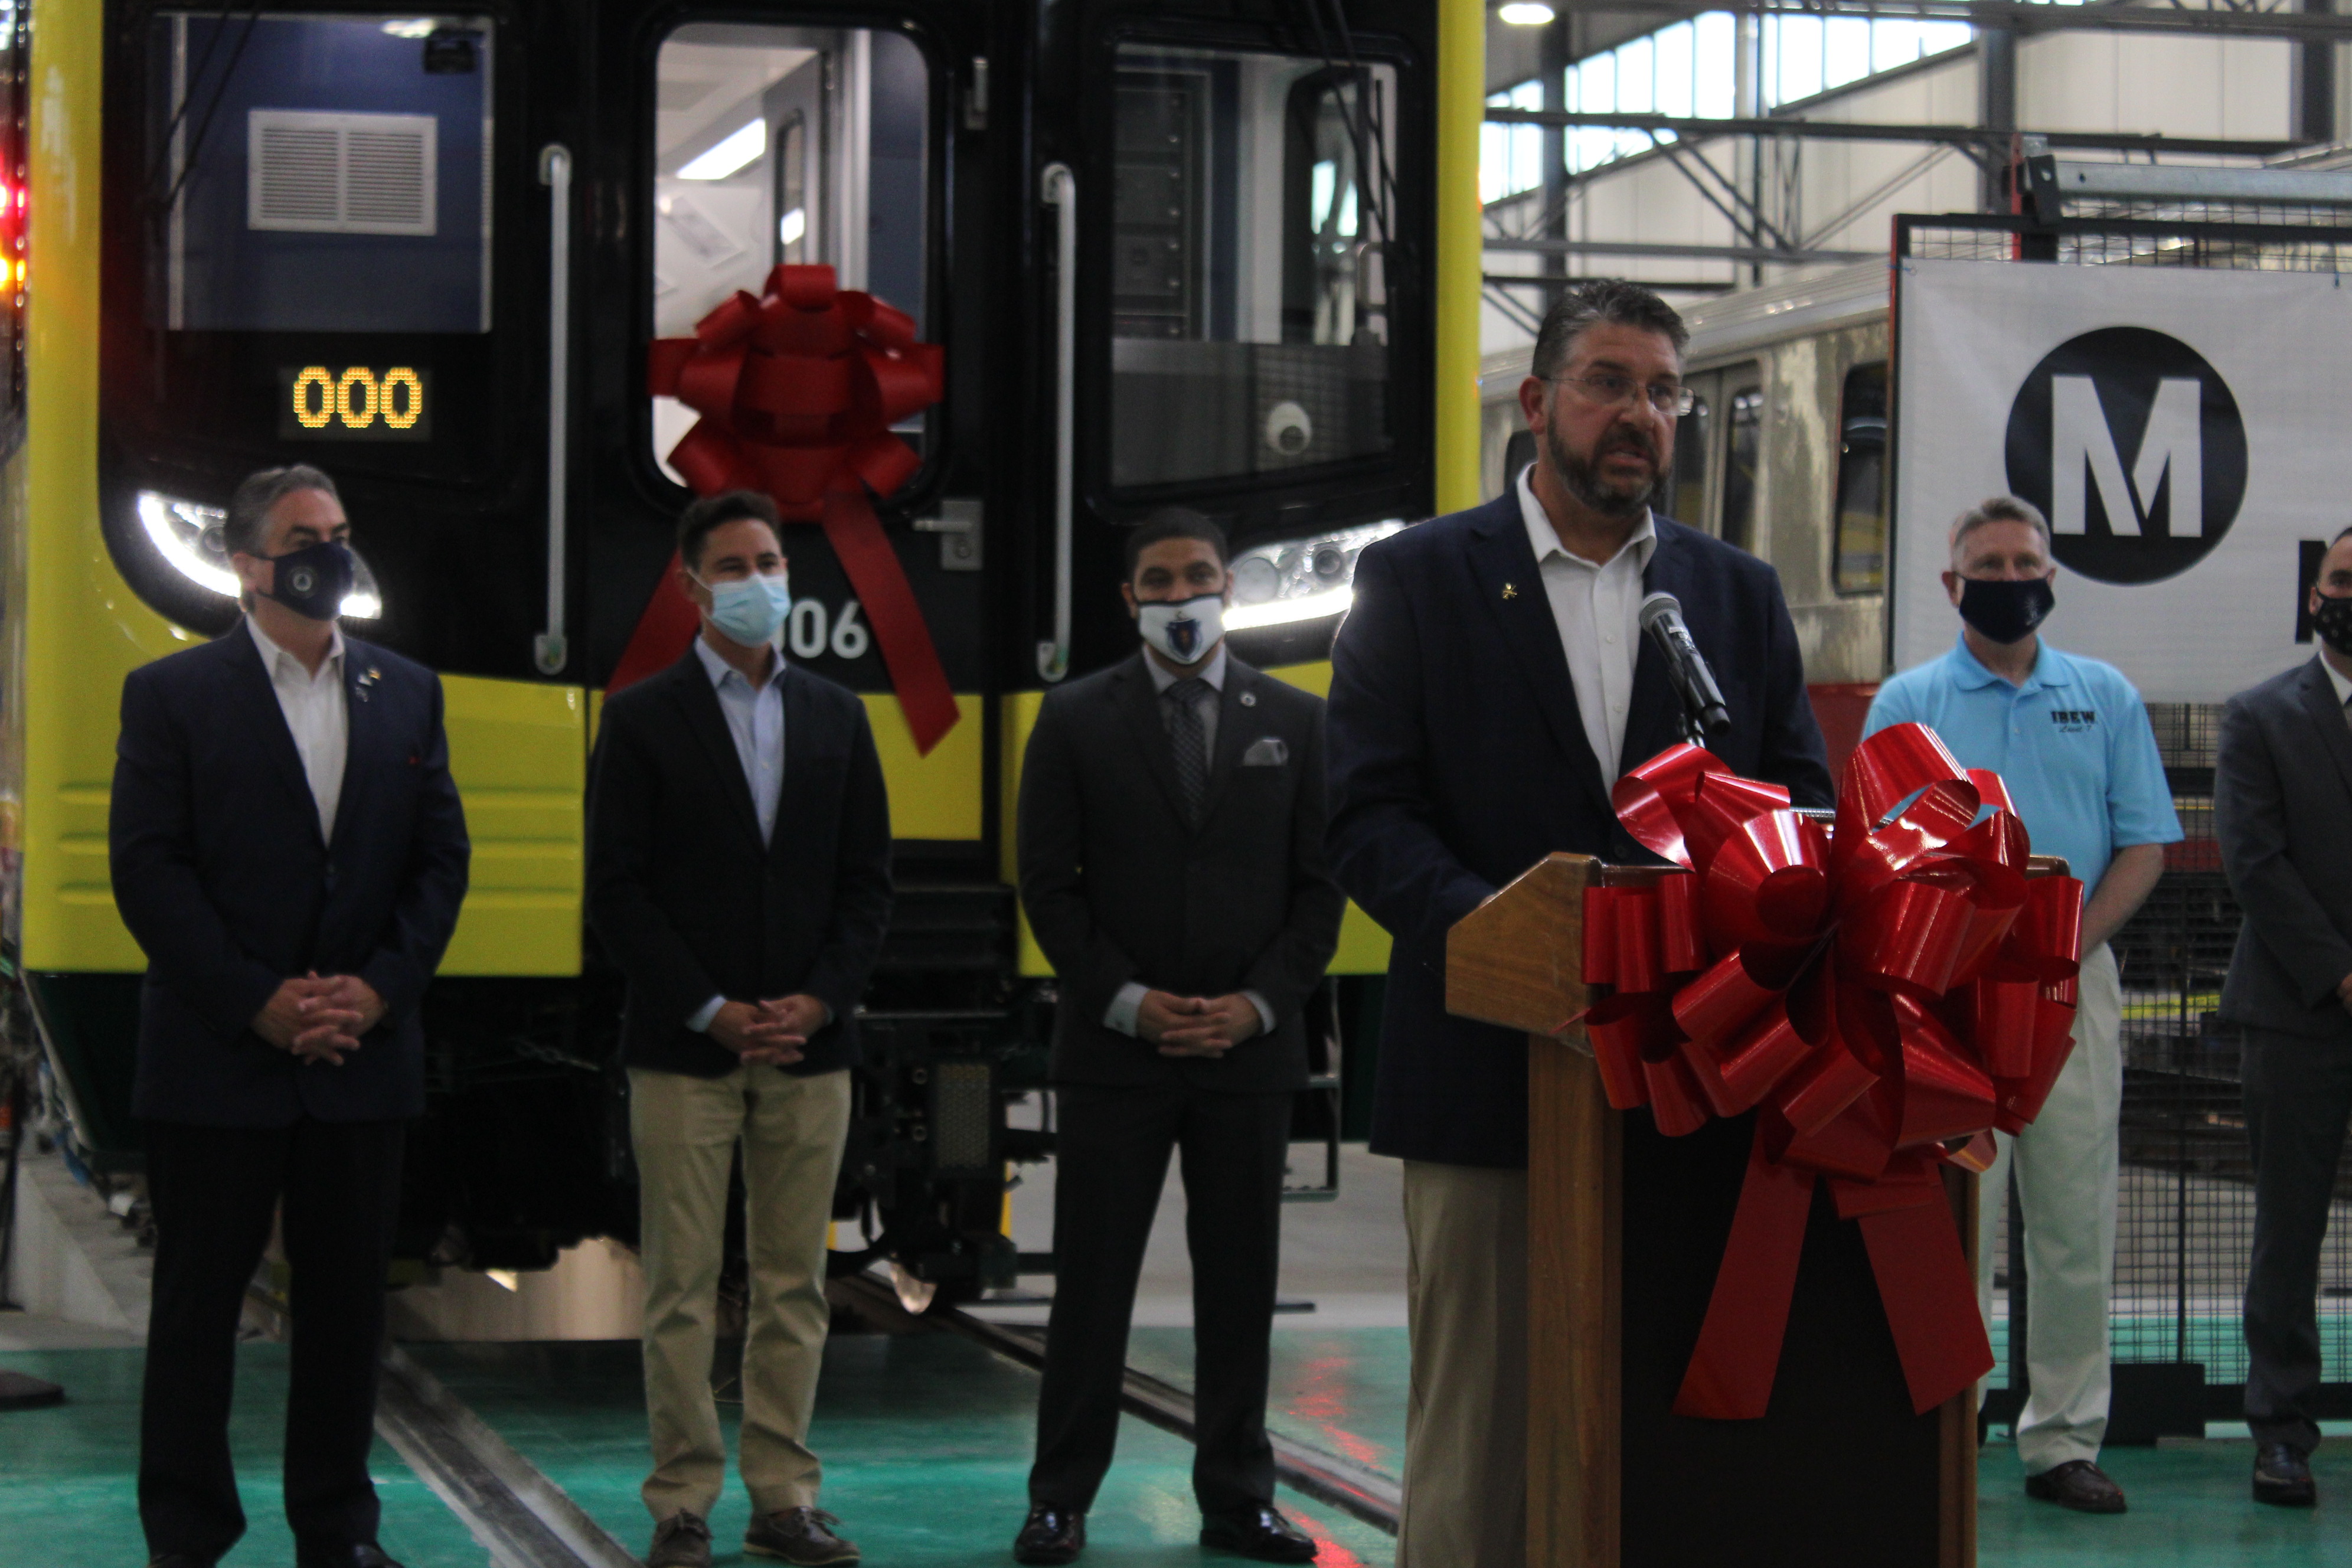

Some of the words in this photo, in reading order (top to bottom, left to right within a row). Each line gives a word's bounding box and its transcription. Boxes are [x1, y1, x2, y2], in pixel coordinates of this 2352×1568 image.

[293, 366, 422, 428] 000
[2052, 374, 2202, 538] M
[775, 599, 869, 659] 06
[2050, 711, 2095, 724] IBEW
